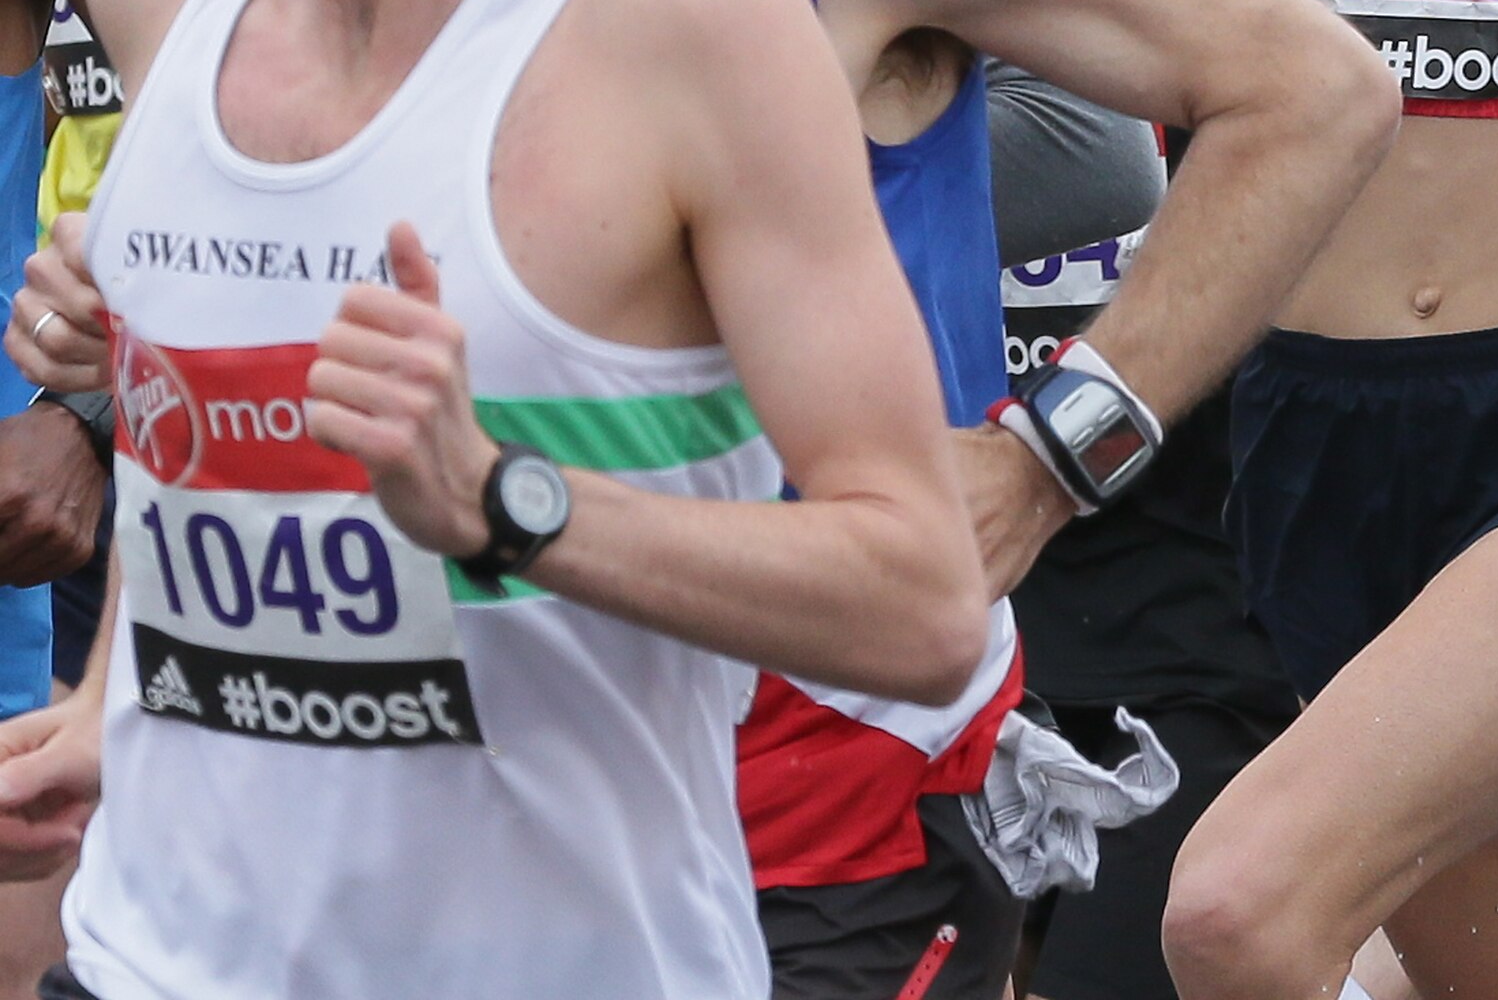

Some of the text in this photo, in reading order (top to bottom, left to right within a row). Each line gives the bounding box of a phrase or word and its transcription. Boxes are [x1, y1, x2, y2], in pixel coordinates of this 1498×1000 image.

[125, 230, 311, 281] SWANSEA
[141, 501, 398, 636] 1049
[218, 671, 458, 740] #boost
